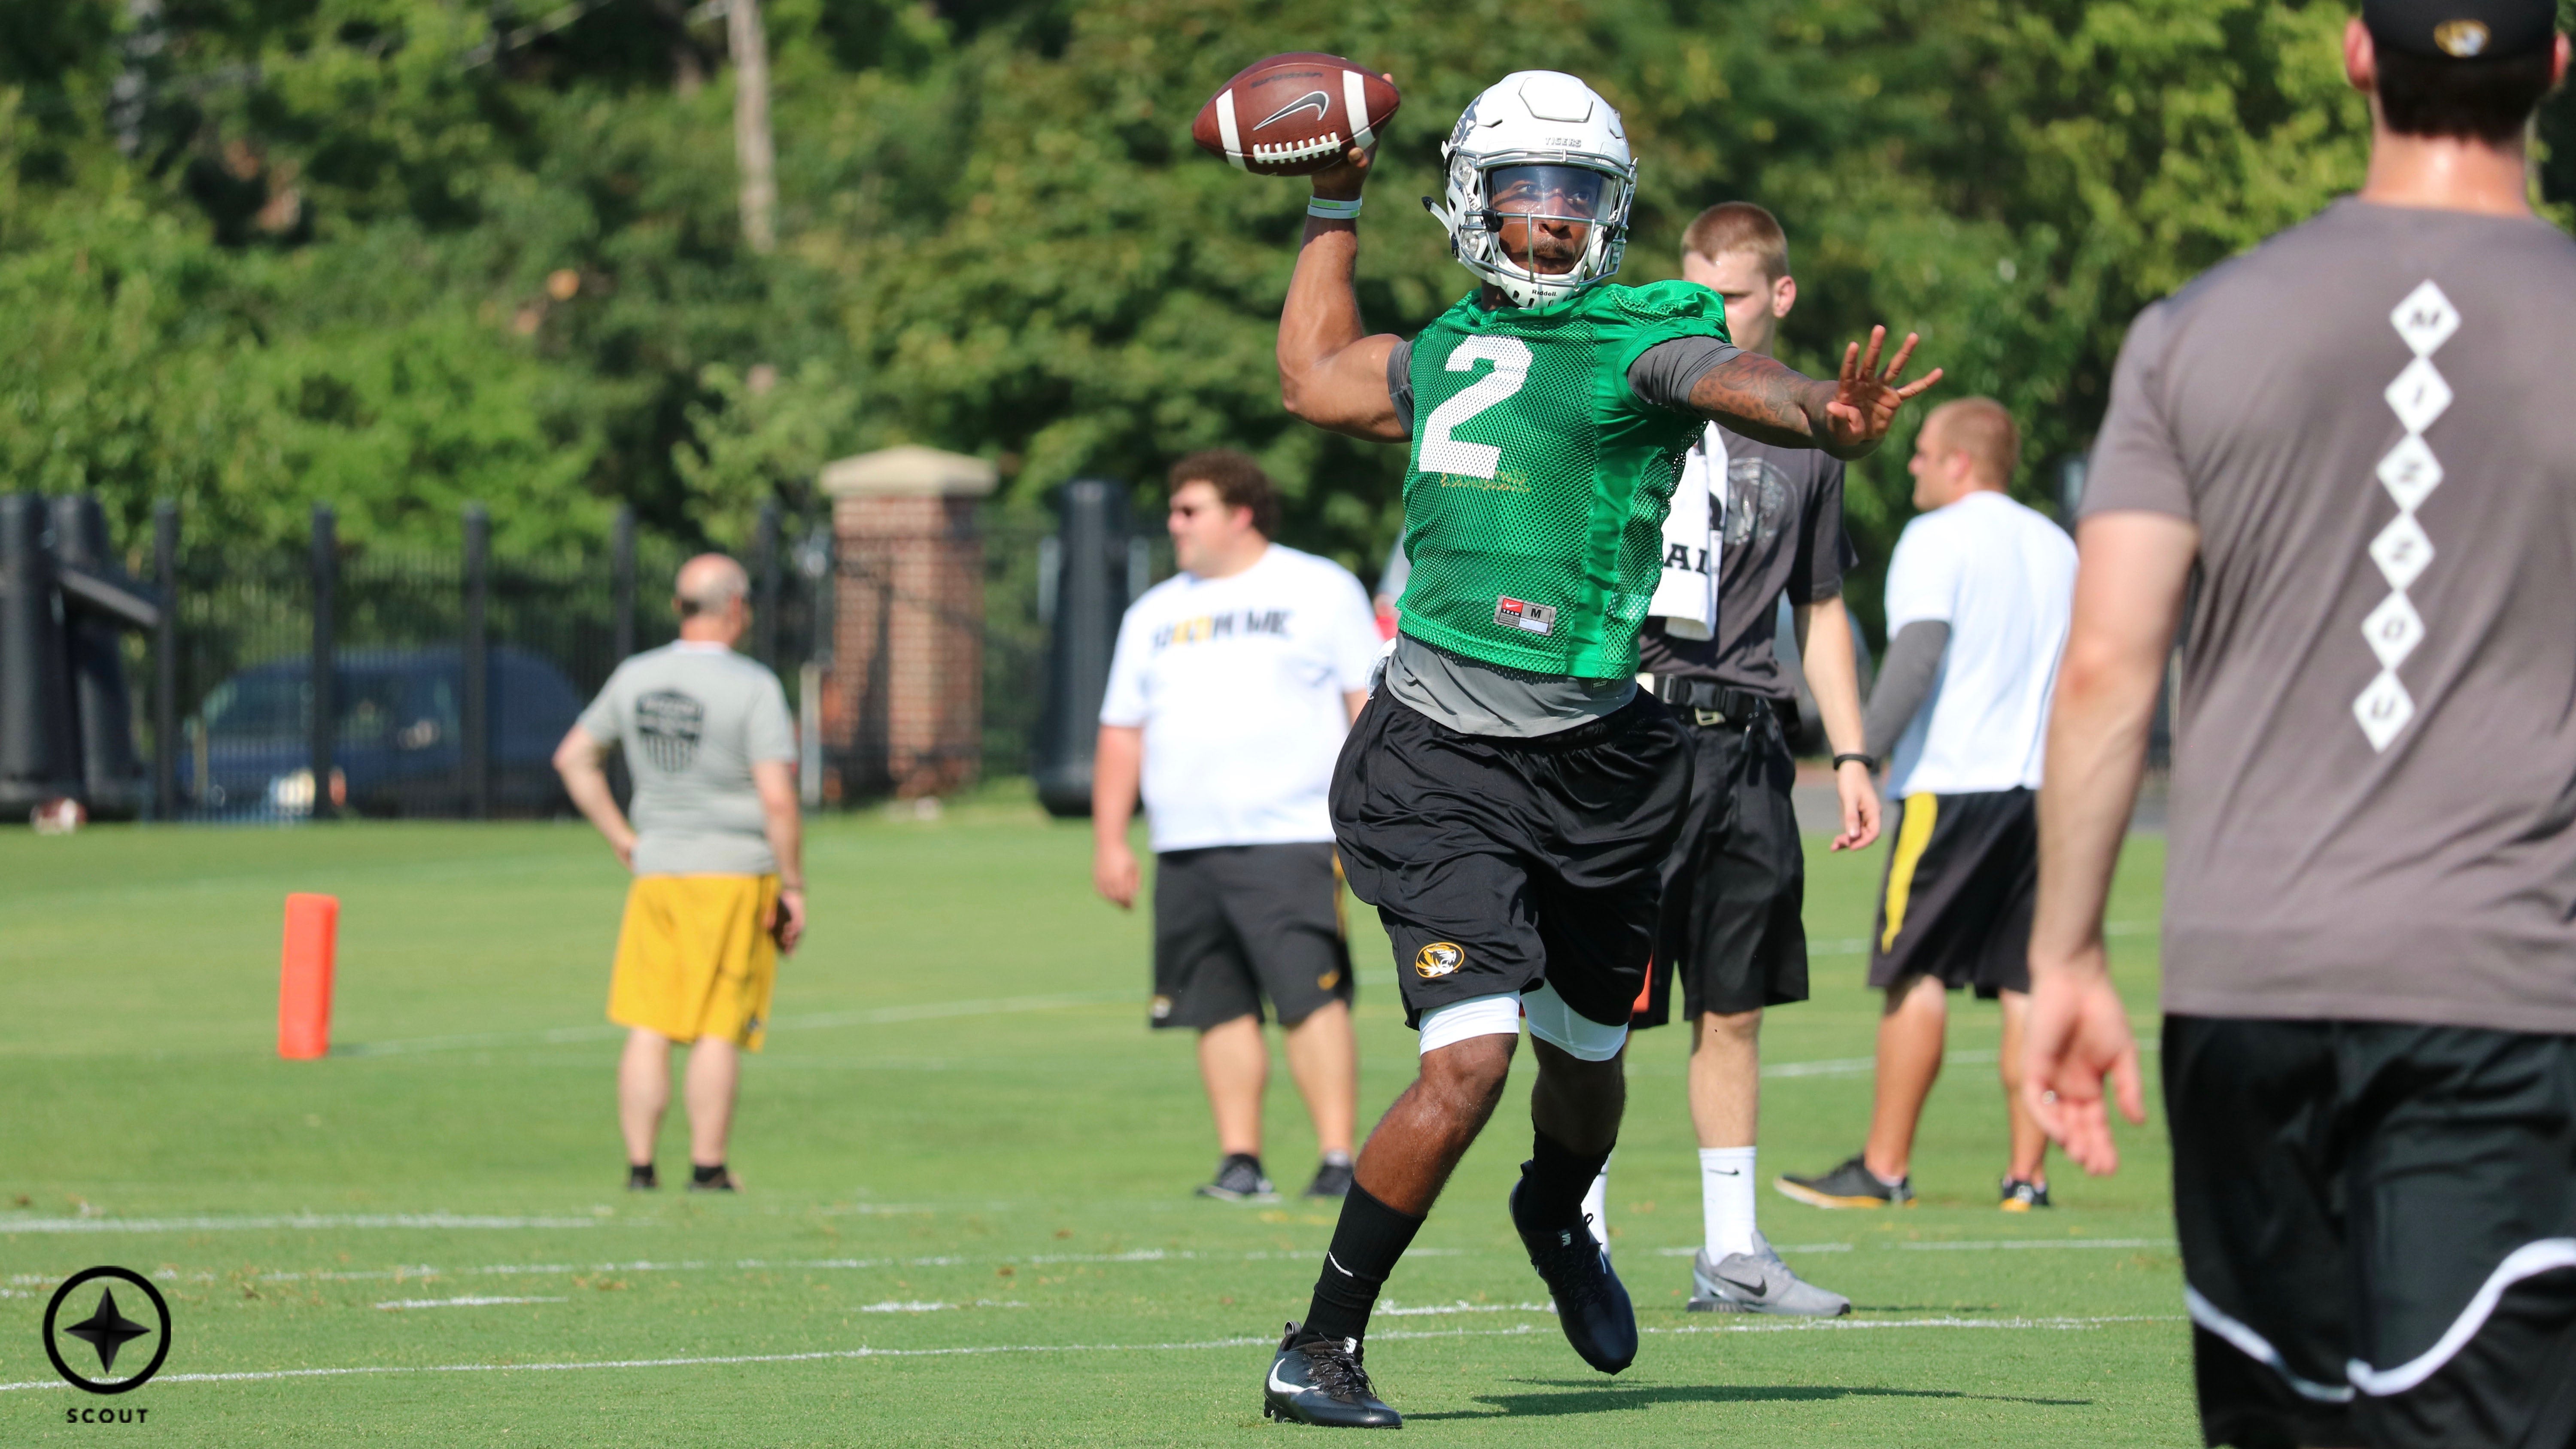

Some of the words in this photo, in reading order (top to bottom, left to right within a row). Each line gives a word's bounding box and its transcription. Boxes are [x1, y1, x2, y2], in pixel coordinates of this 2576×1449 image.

[1545, 137, 1582, 148] TIGERS
[1419, 334, 1533, 480] 2
[1531, 608, 1542, 619] M
